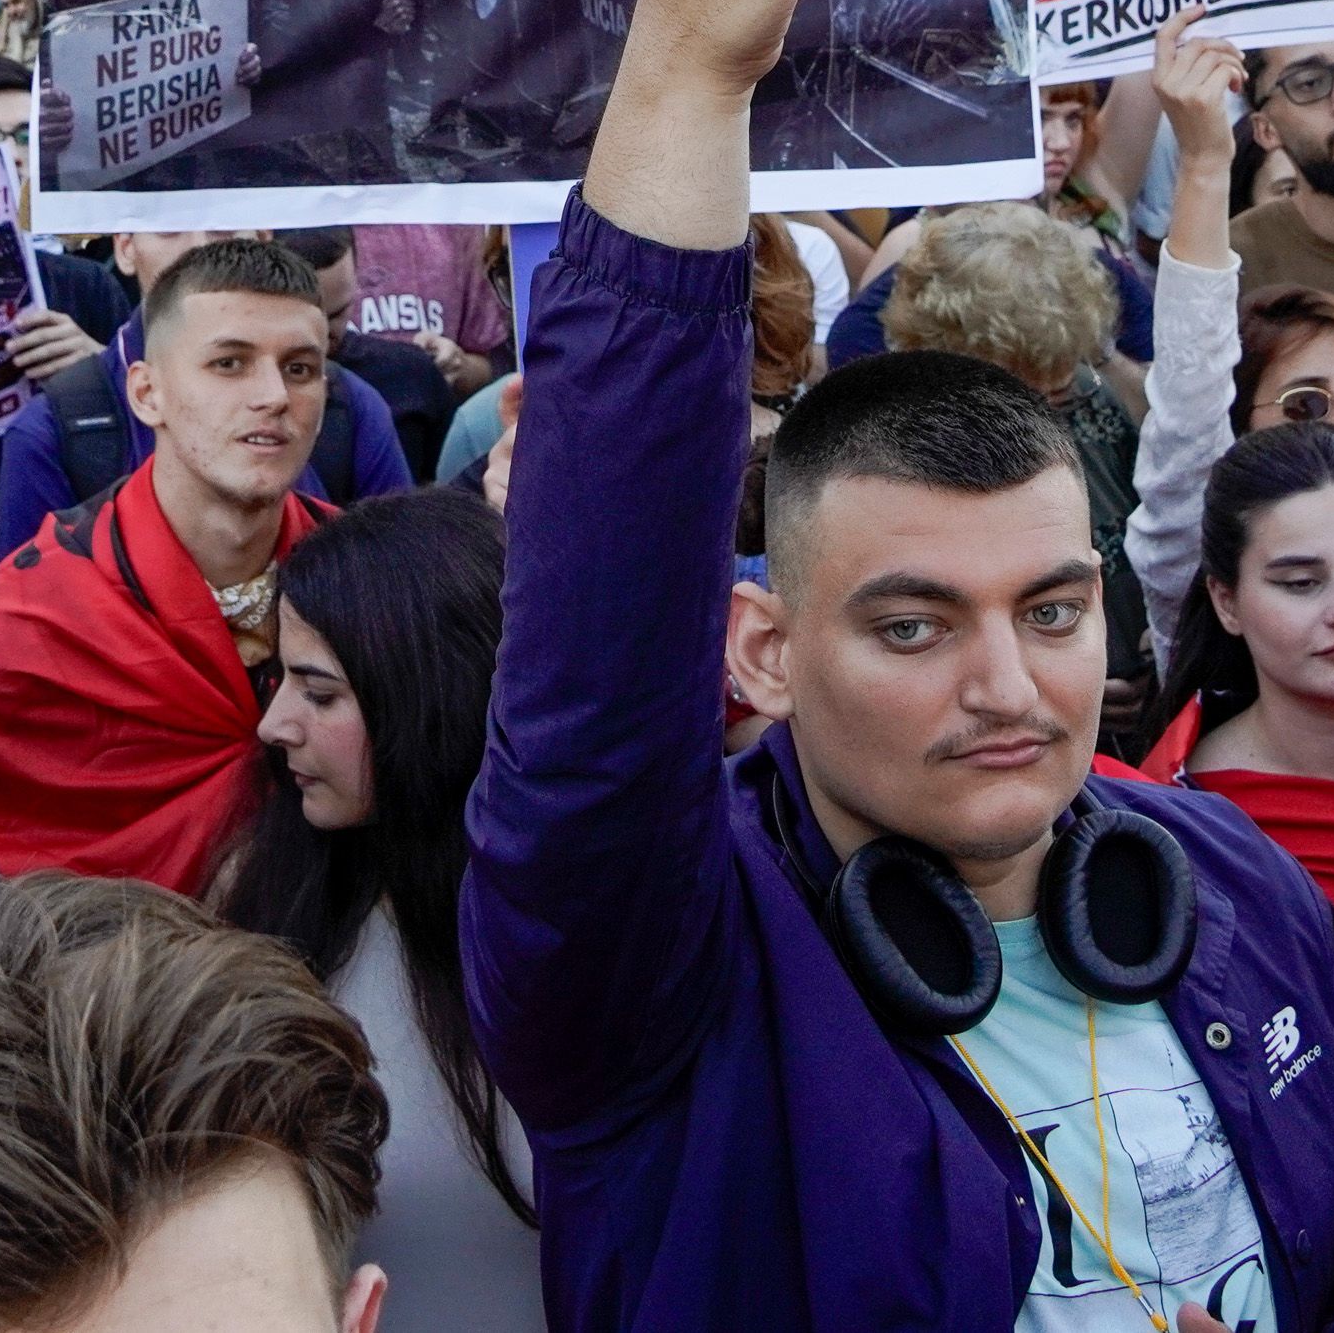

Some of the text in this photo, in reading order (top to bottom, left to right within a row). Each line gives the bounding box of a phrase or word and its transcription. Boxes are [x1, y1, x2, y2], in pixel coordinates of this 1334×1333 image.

[97, 25, 223, 88] NE BURG
[97, 64, 222, 133] BERISHA
[99, 96, 223, 170] NE BURG
[1269, 1044, 1322, 1100] new balance
